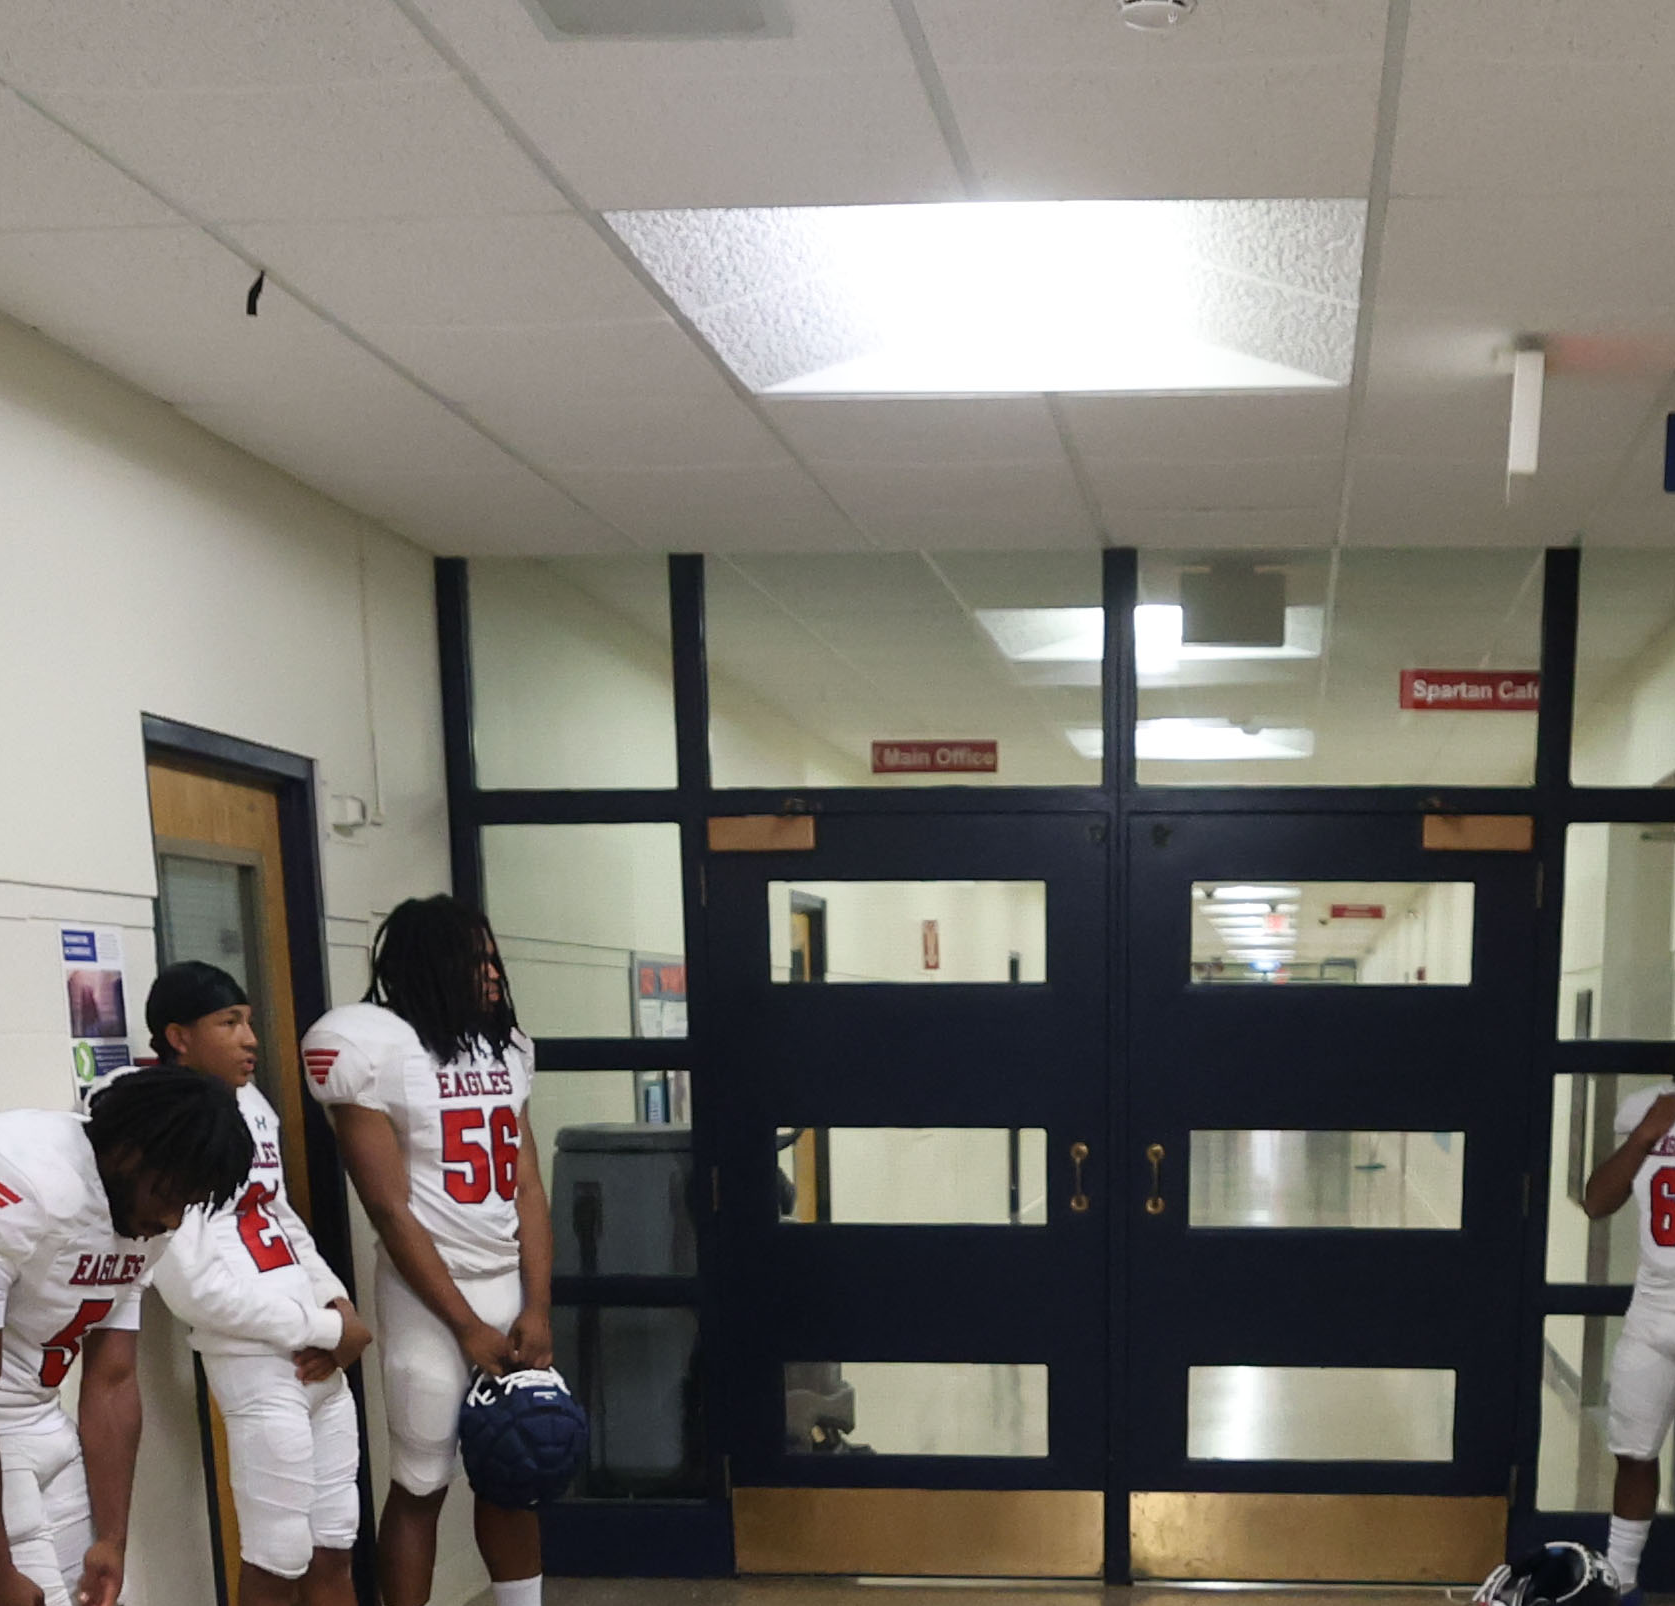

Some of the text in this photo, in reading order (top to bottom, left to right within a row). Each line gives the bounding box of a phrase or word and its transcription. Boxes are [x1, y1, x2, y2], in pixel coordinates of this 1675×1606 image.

[1413, 678, 1493, 704] Spartan
[883, 747, 995, 767] Main Office
[437, 1069, 513, 1099] EAGLES
[441, 1105, 522, 1204] 56
[69, 1254, 146, 1286] EAGLES
